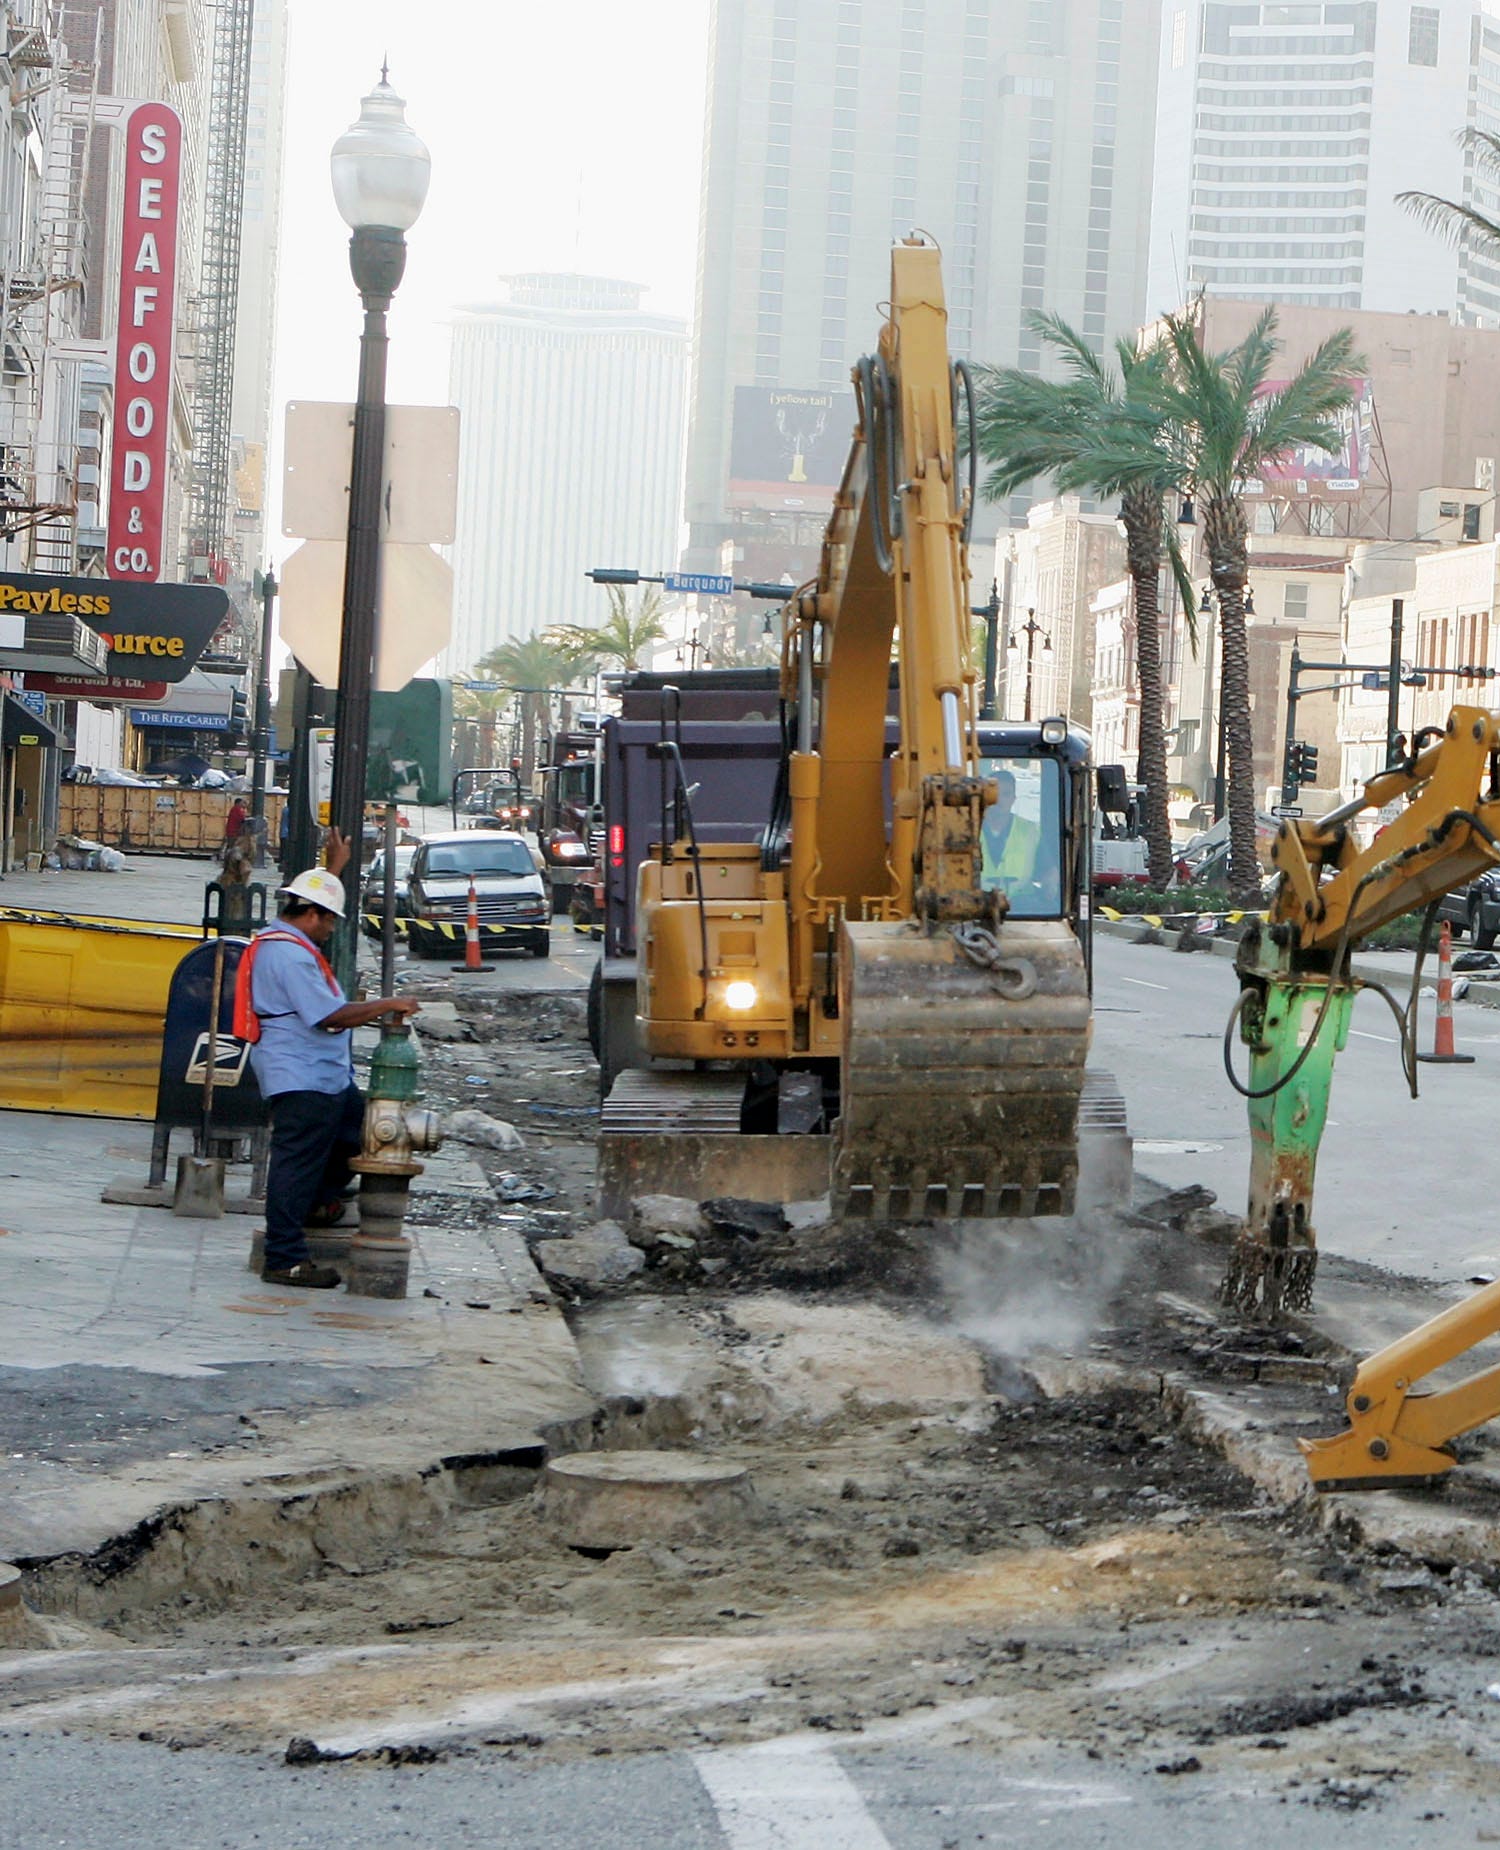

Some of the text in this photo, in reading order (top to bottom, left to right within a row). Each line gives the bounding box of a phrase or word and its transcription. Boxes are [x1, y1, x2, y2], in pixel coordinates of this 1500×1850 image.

[123, 124, 166, 533] SEAFOOD &
[114, 548, 153, 573] CO.
[674, 574, 731, 593] Burgundy
[0, 584, 111, 615] Payless
[139, 712, 227, 726] THE RITZ-CARLTO
